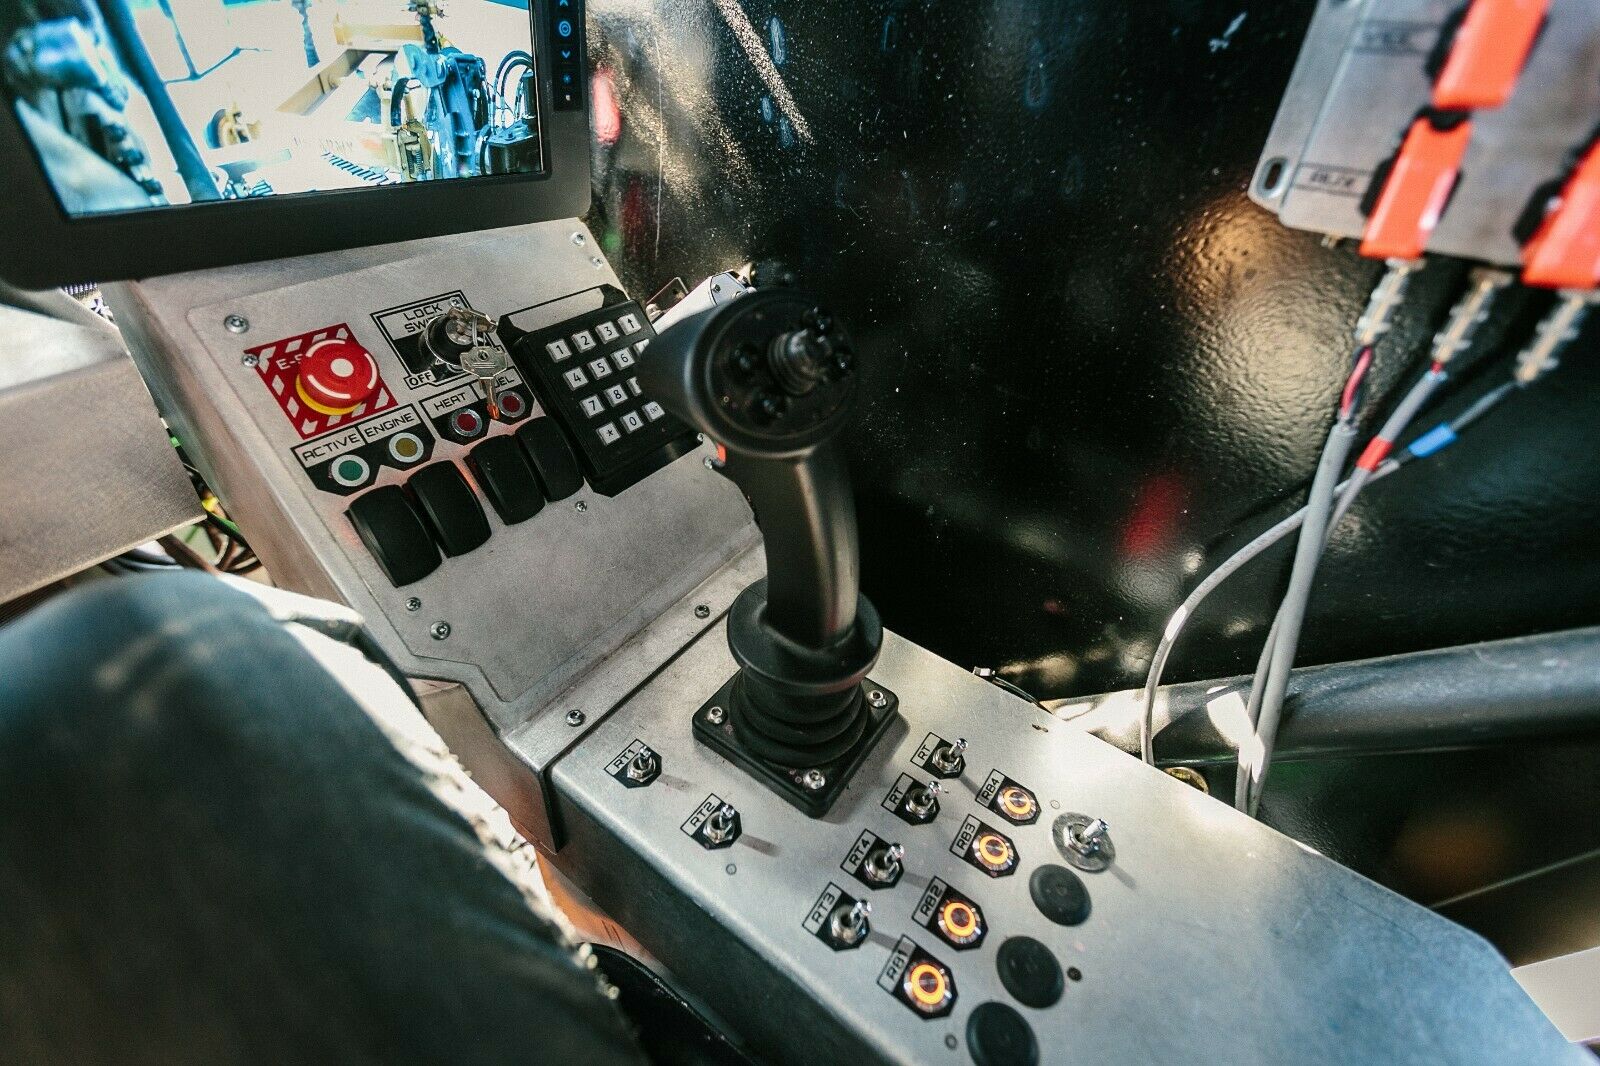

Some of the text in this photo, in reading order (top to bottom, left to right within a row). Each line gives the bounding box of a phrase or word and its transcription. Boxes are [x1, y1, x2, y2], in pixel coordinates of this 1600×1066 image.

[403, 302, 443, 321] LOCK
[555, 326, 613, 355] 1 2 3
[409, 371, 432, 386] OFF
[573, 353, 629, 382] 4 5 6
[434, 392, 467, 411] HEAT
[588, 389, 622, 411] 7 8
[628, 416, 637, 426] 0
[302, 412, 414, 461] ACTIVE ENGINE
[613, 748, 635, 769] RT1
[917, 744, 931, 761] RT
[888, 786, 904, 806] RT
[981, 777, 1000, 802] RB4
[690, 801, 715, 828] RT2
[956, 823, 976, 850] RB3
[849, 837, 871, 867] RT4
[811, 892, 836, 924] RT3
[919, 884, 943, 917] RB2
[885, 949, 909, 981] RB1
